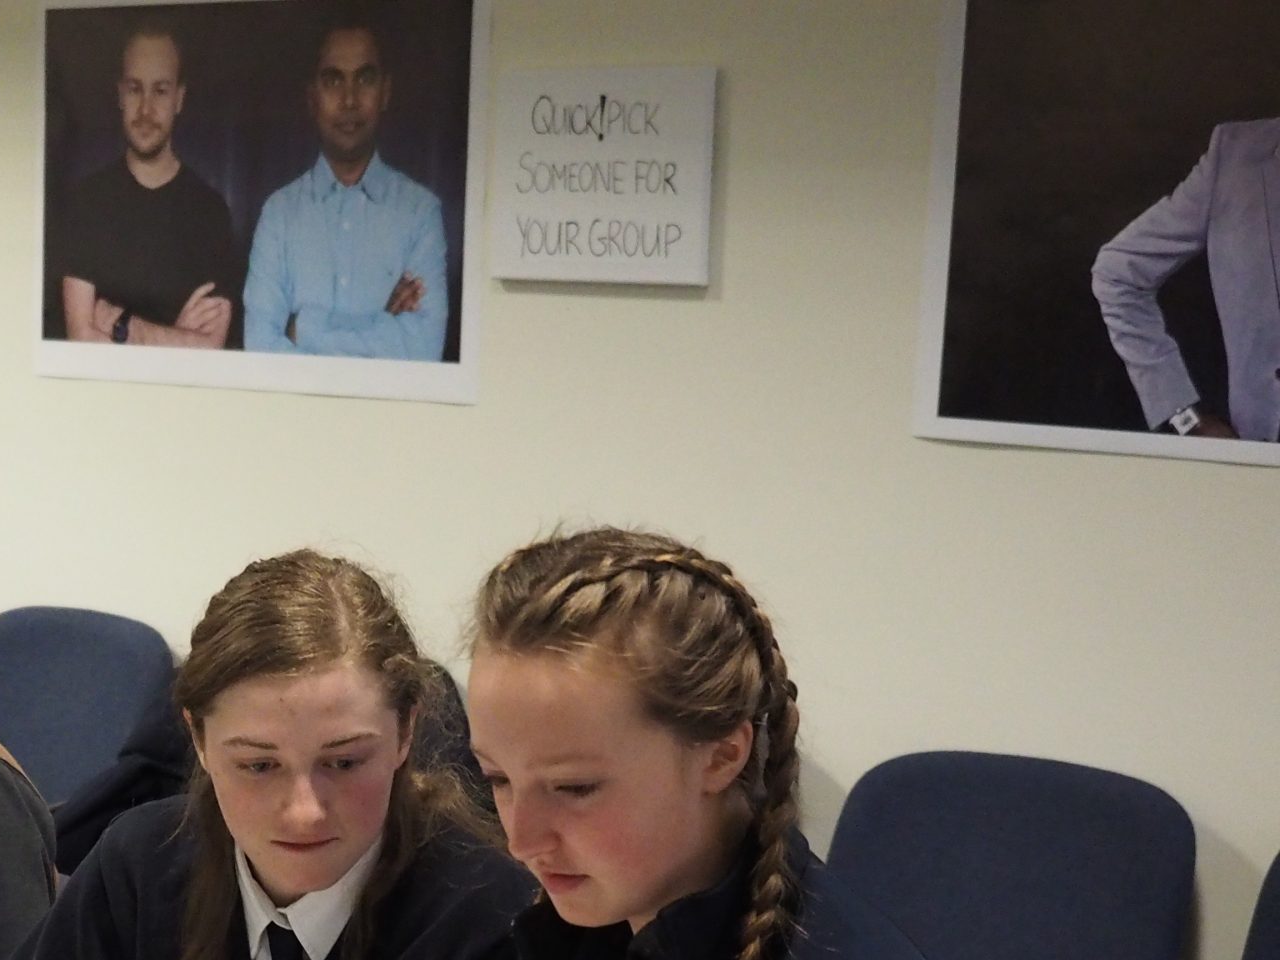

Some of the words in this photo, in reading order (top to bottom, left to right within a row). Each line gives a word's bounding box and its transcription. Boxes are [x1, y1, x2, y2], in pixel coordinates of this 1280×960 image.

[516, 151, 627, 194] SOMEONE
[634, 159, 678, 195] FOR
[516, 216, 582, 257] YOUR
[588, 218, 682, 258] GROUP
